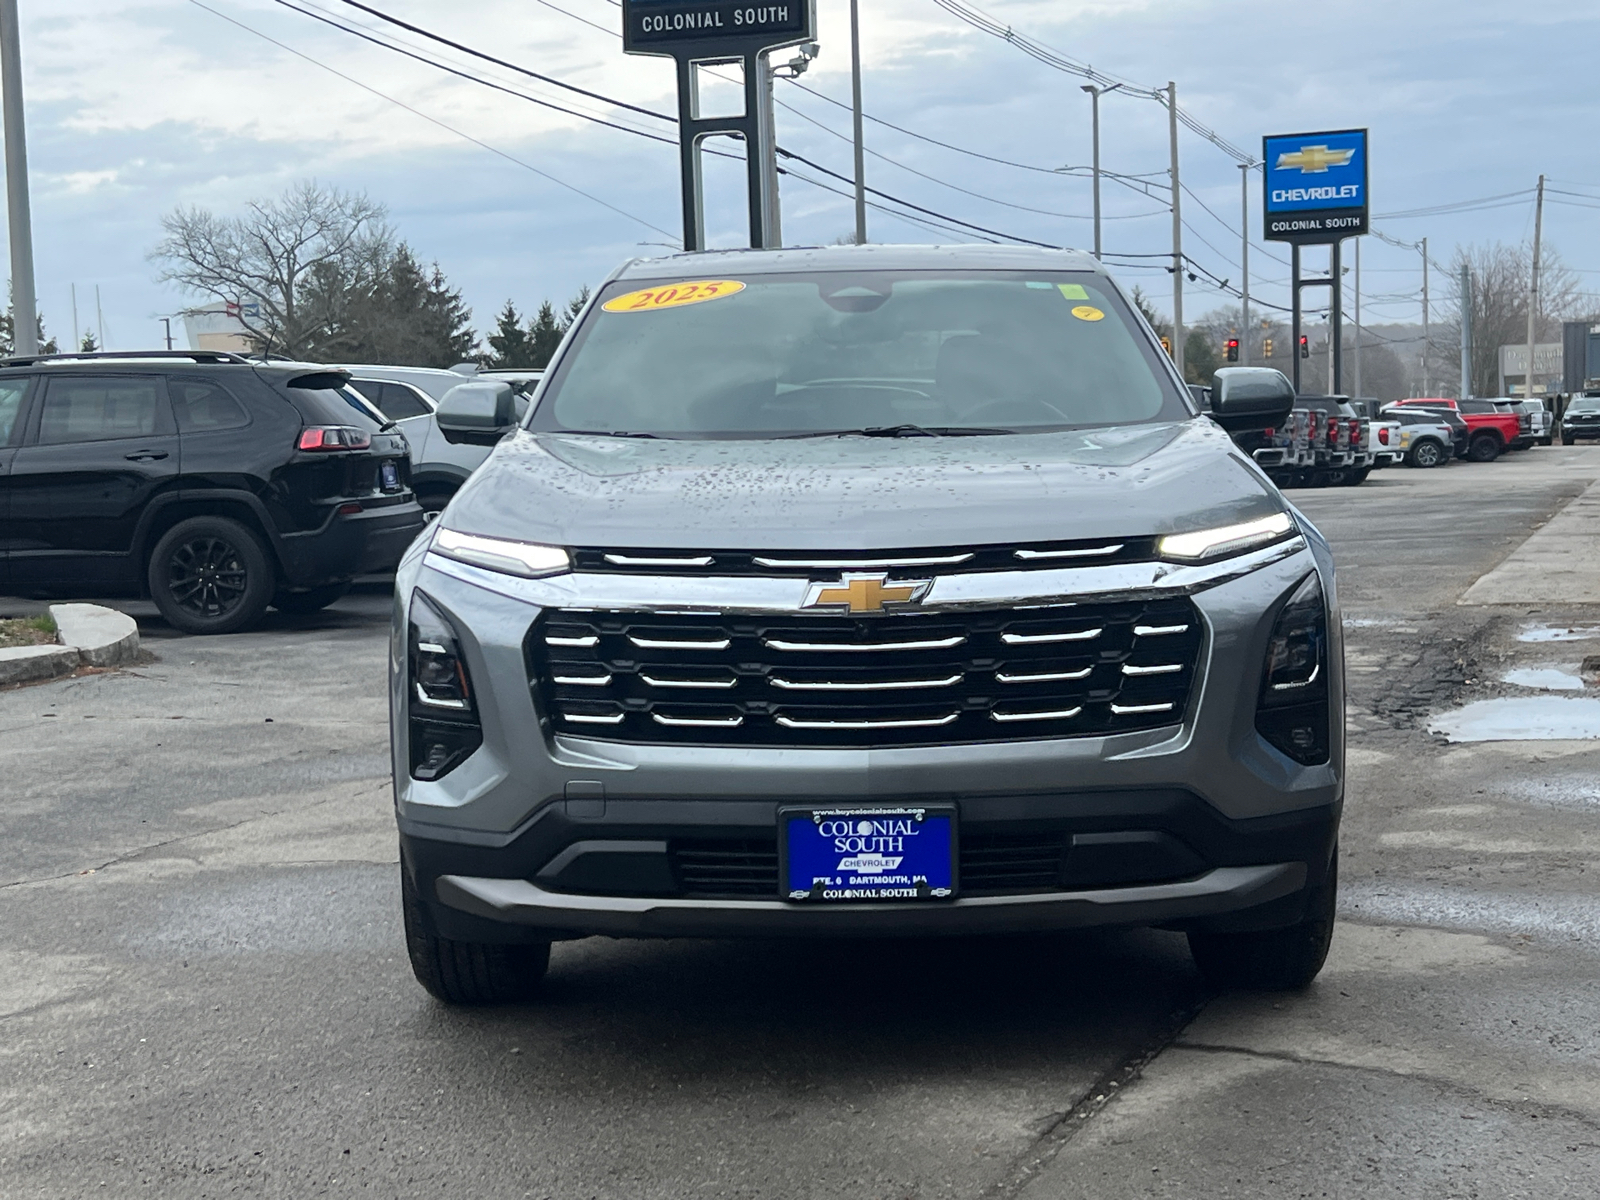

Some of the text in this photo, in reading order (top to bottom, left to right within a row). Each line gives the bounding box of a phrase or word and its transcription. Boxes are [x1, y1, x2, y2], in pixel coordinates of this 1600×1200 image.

[642, 6, 788, 32] COLONIAL SOUTH
[1272, 185, 1359, 202] CHEVROLET
[1271, 217, 1360, 232] COLONIAL SOUTH
[629, 281, 723, 310] 2025
[812, 808, 926, 816] www.buycolonialsouth.com
[819, 820, 919, 837] COLONIAL
[835, 837, 903, 852] SOUTH
[843, 860, 896, 868] CHEVROLET
[836, 877, 842, 885] 6
[849, 876, 911, 885] DARTMOUTH,
[822, 888, 918, 898] COLONIAL SOUTH
